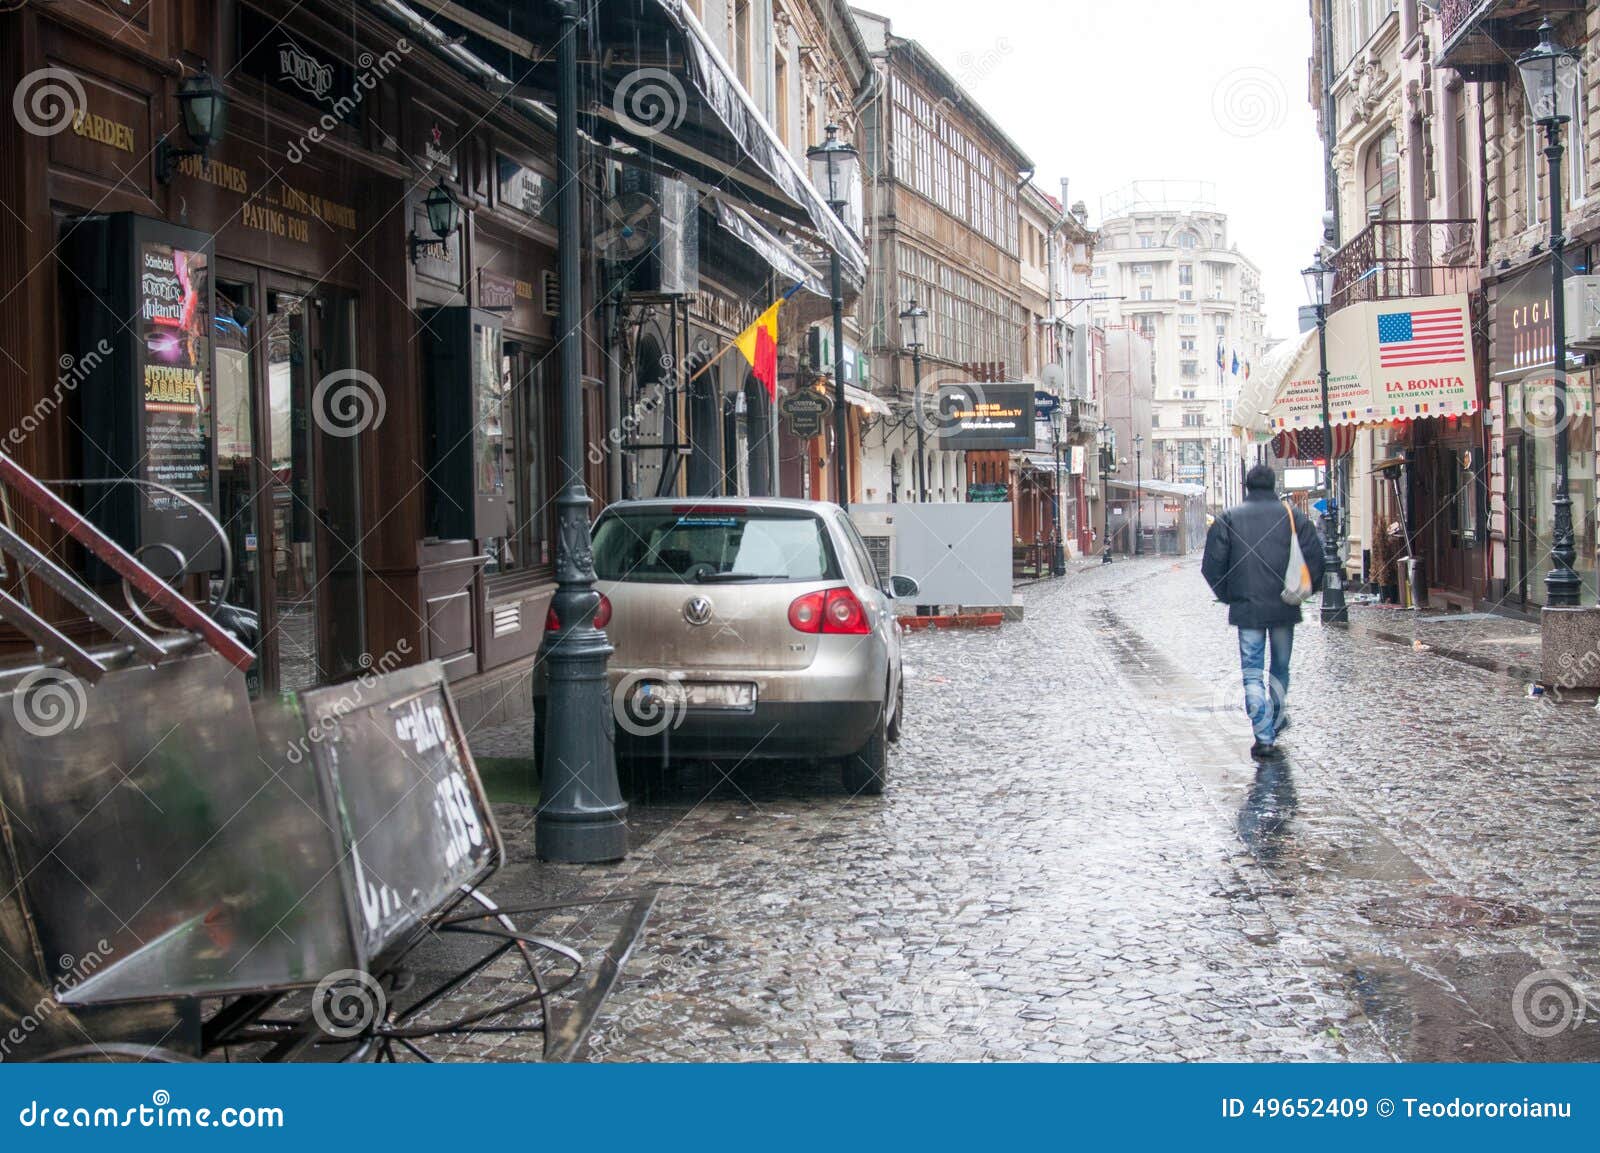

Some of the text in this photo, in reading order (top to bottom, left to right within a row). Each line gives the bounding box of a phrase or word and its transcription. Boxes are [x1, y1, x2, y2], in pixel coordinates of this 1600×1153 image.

[73, 108, 135, 152] GARDEN
[242, 201, 309, 243] PAYING FOR
[1386, 377, 1464, 392] LA BONITA
[1388, 390, 1434, 399] RESTAURANT
